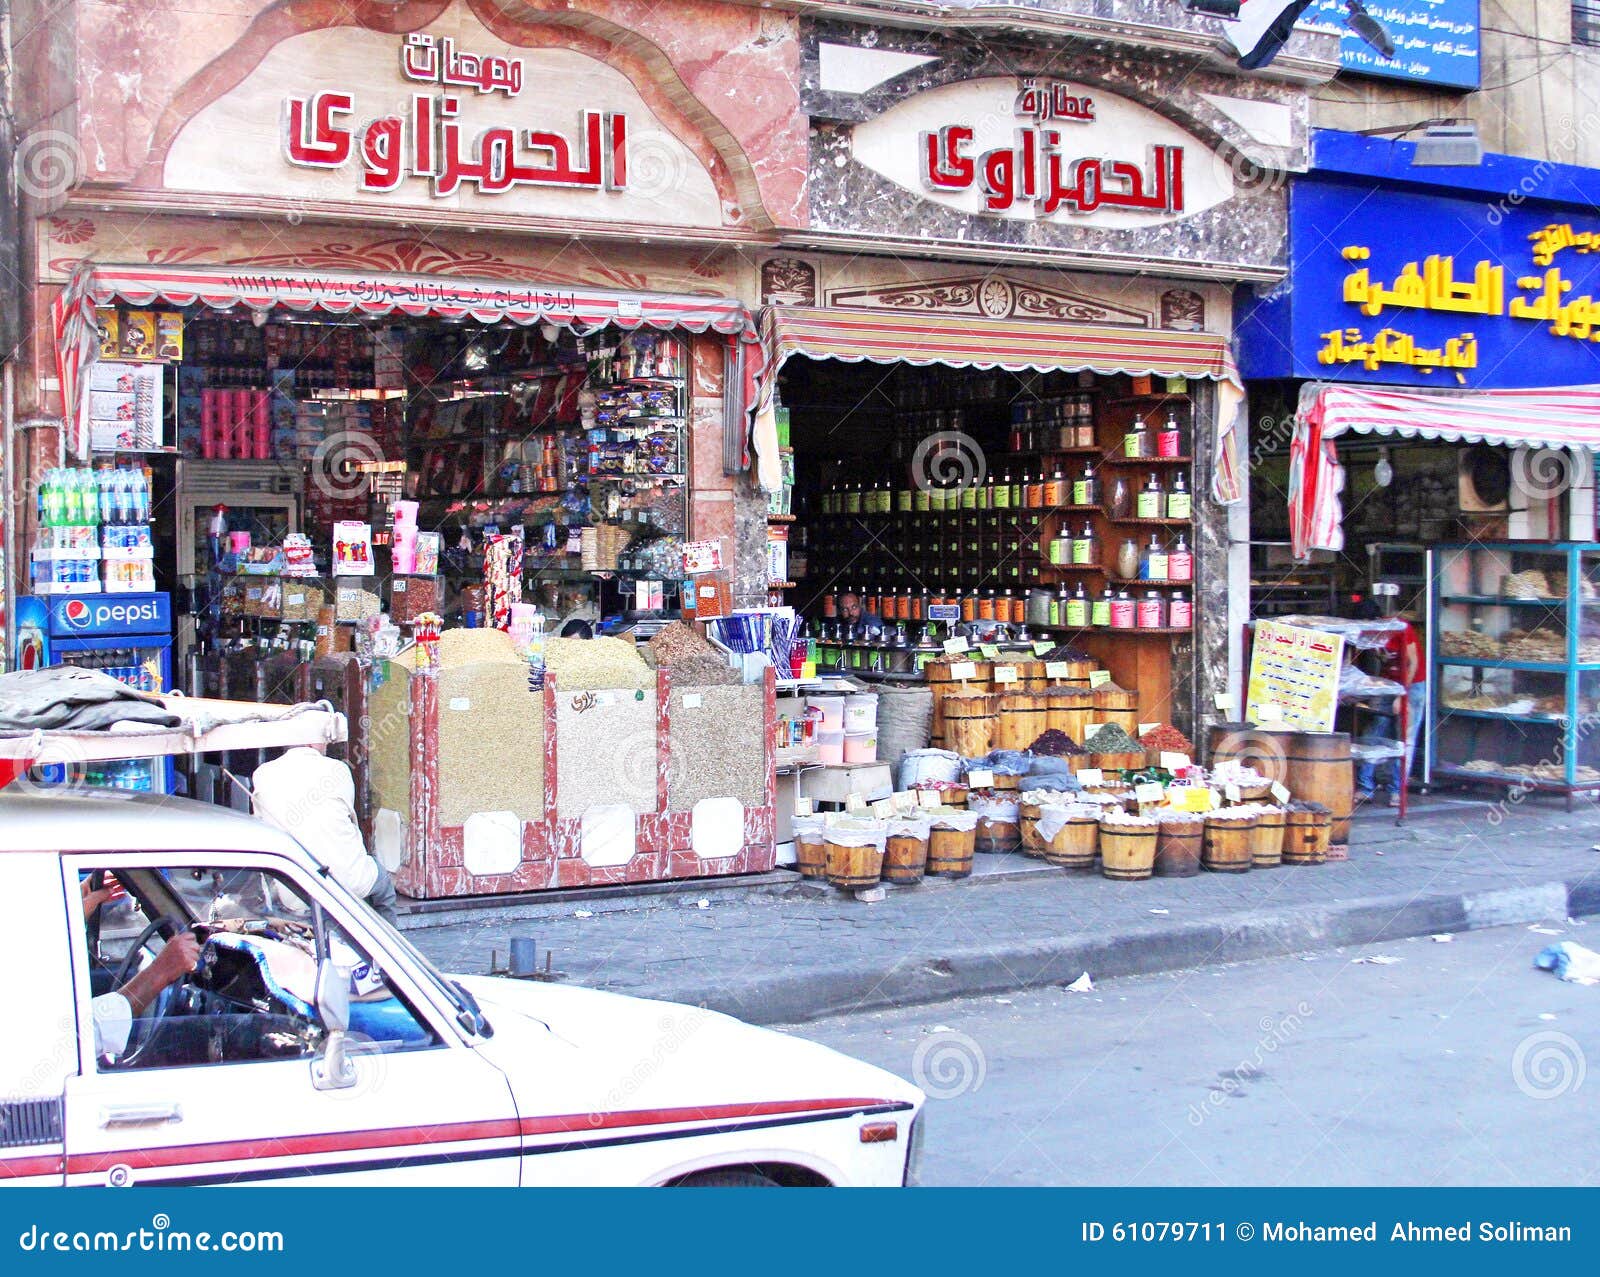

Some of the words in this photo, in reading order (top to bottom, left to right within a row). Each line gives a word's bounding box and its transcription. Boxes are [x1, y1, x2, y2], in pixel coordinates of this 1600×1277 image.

[1014, 79, 1096, 123] عطارة
[284, 90, 628, 197] الحمزاوى
[920, 121, 1184, 219] الحمزاوى
[428, 283, 483, 306] شعبان
[1341, 245, 1503, 317] الطاهرة
[96, 600, 158, 627] pepsi
